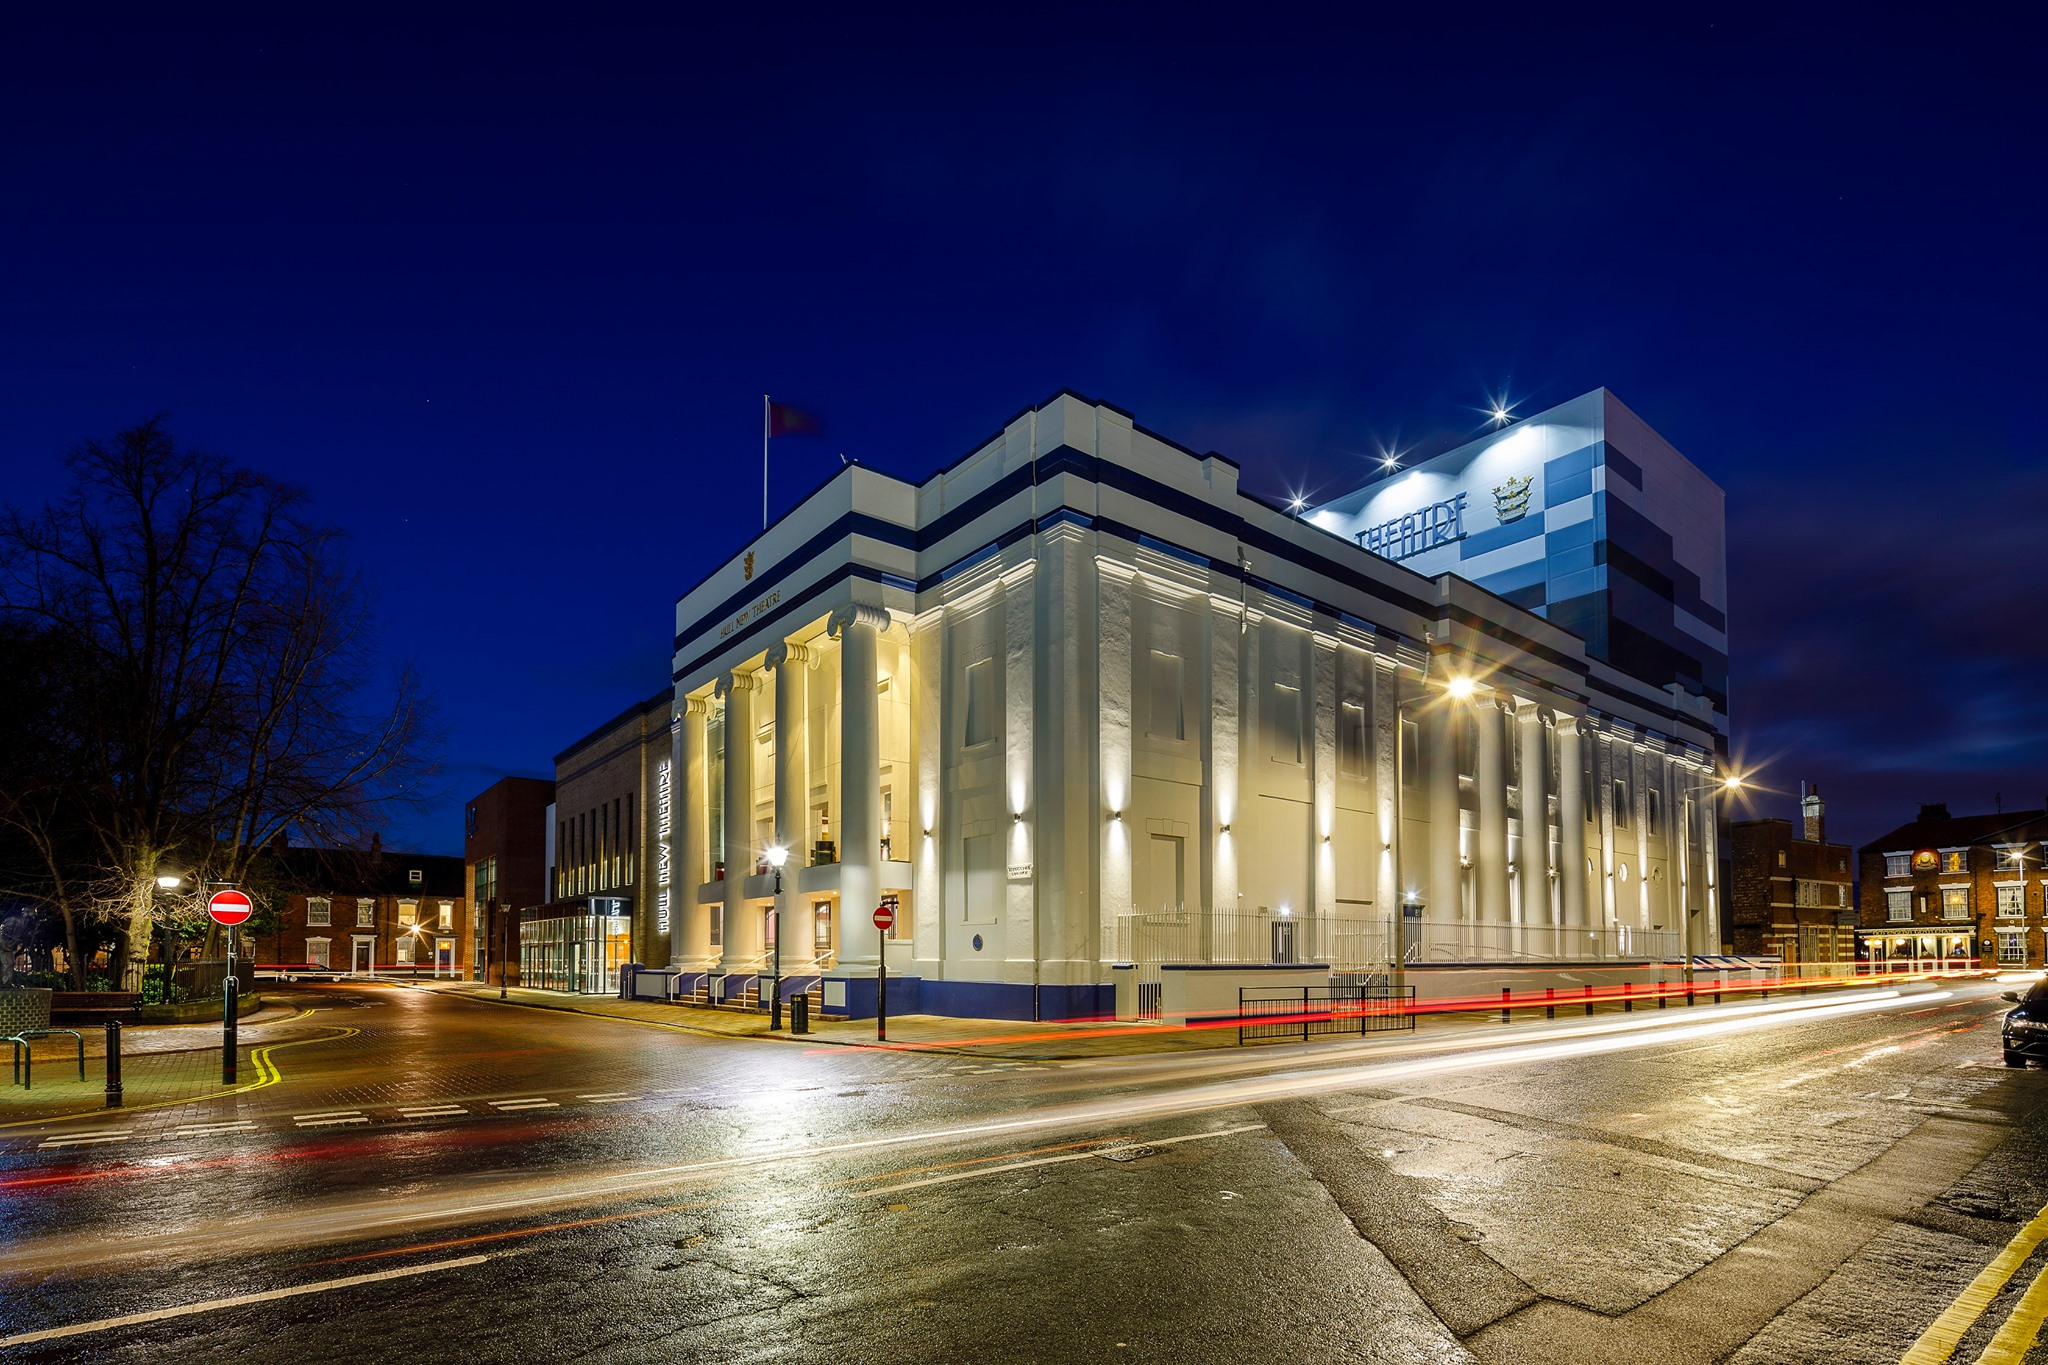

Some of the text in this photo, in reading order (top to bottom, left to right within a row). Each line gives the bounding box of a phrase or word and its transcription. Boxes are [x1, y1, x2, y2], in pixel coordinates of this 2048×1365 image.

[720, 590, 781, 639] HULL NEW THEATRE
[658, 757, 672, 934] HULL NEW THEATRE
